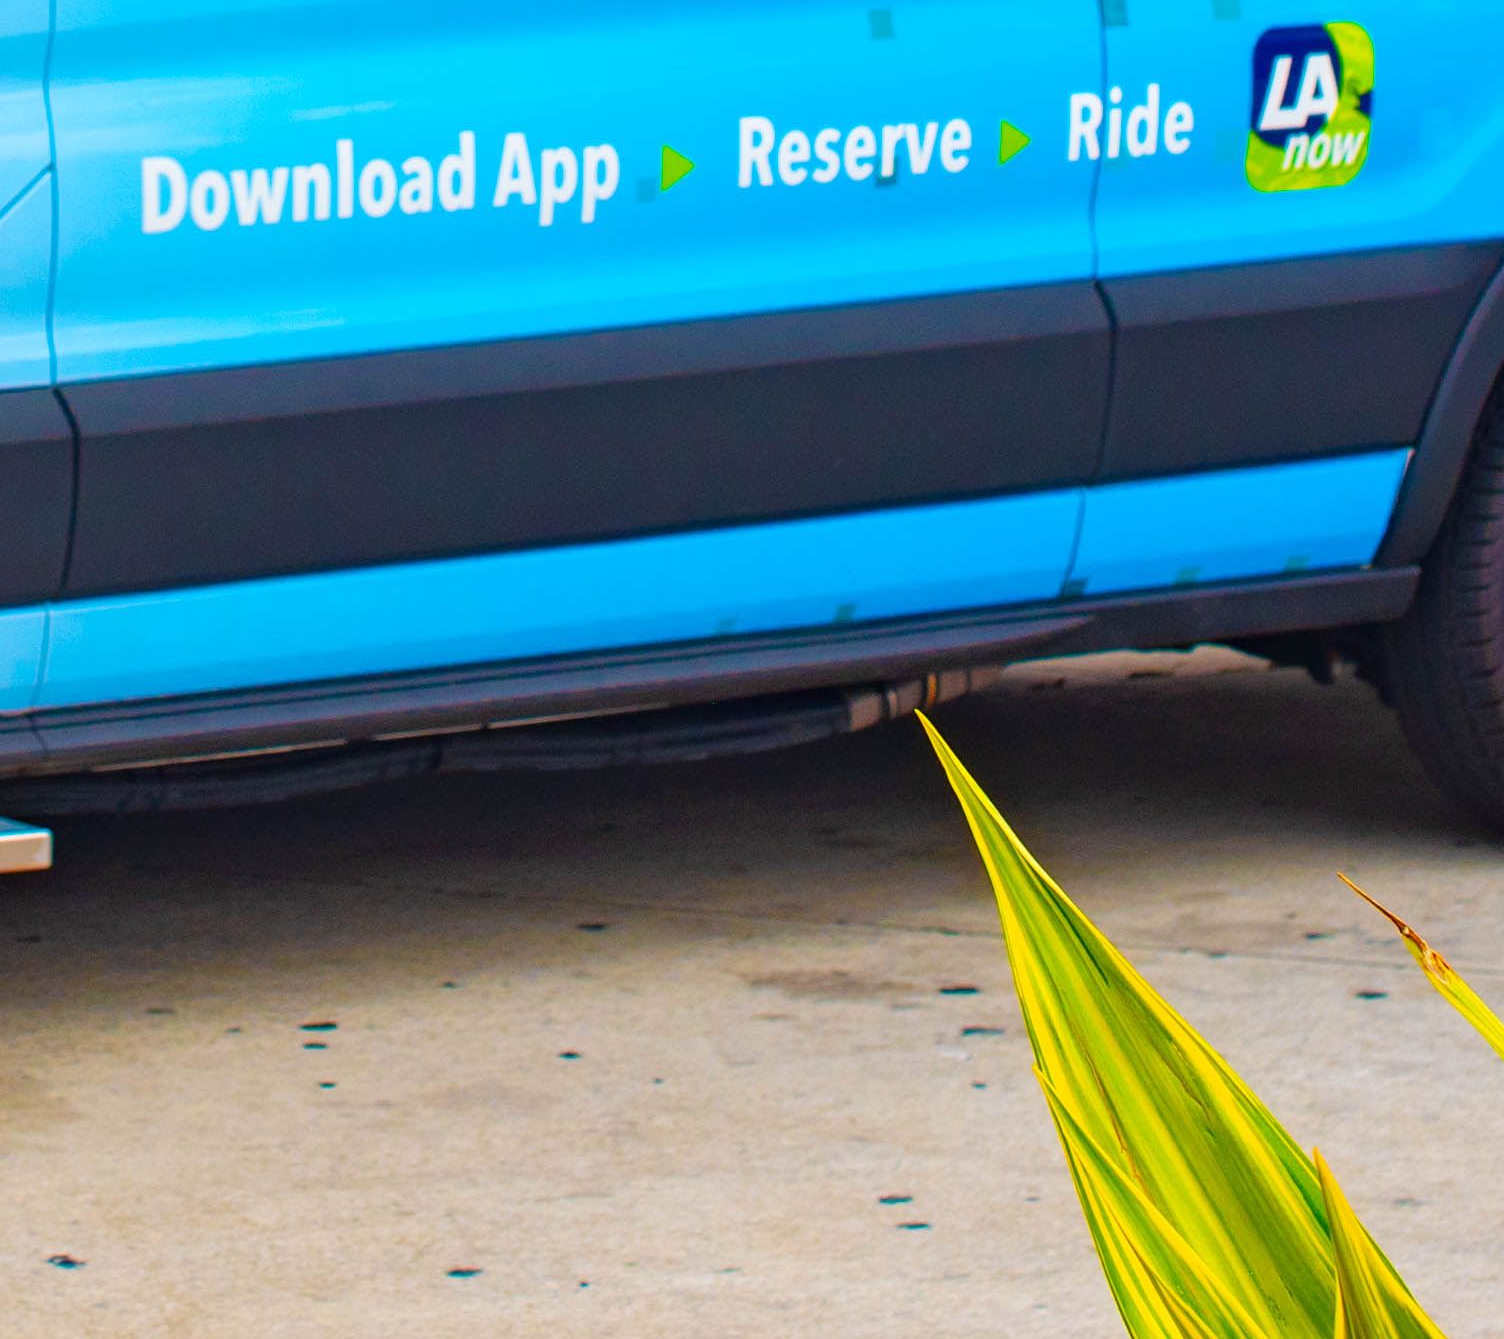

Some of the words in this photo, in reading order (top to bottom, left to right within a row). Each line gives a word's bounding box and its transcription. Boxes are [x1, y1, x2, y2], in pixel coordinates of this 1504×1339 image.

[1258, 53, 1340, 132] LA
[140, 131, 475, 235] Download
[493, 129, 620, 227] App
[735, 112, 974, 190] Reserve
[1065, 79, 1195, 164] Ride
[1282, 130, 1366, 173] now
